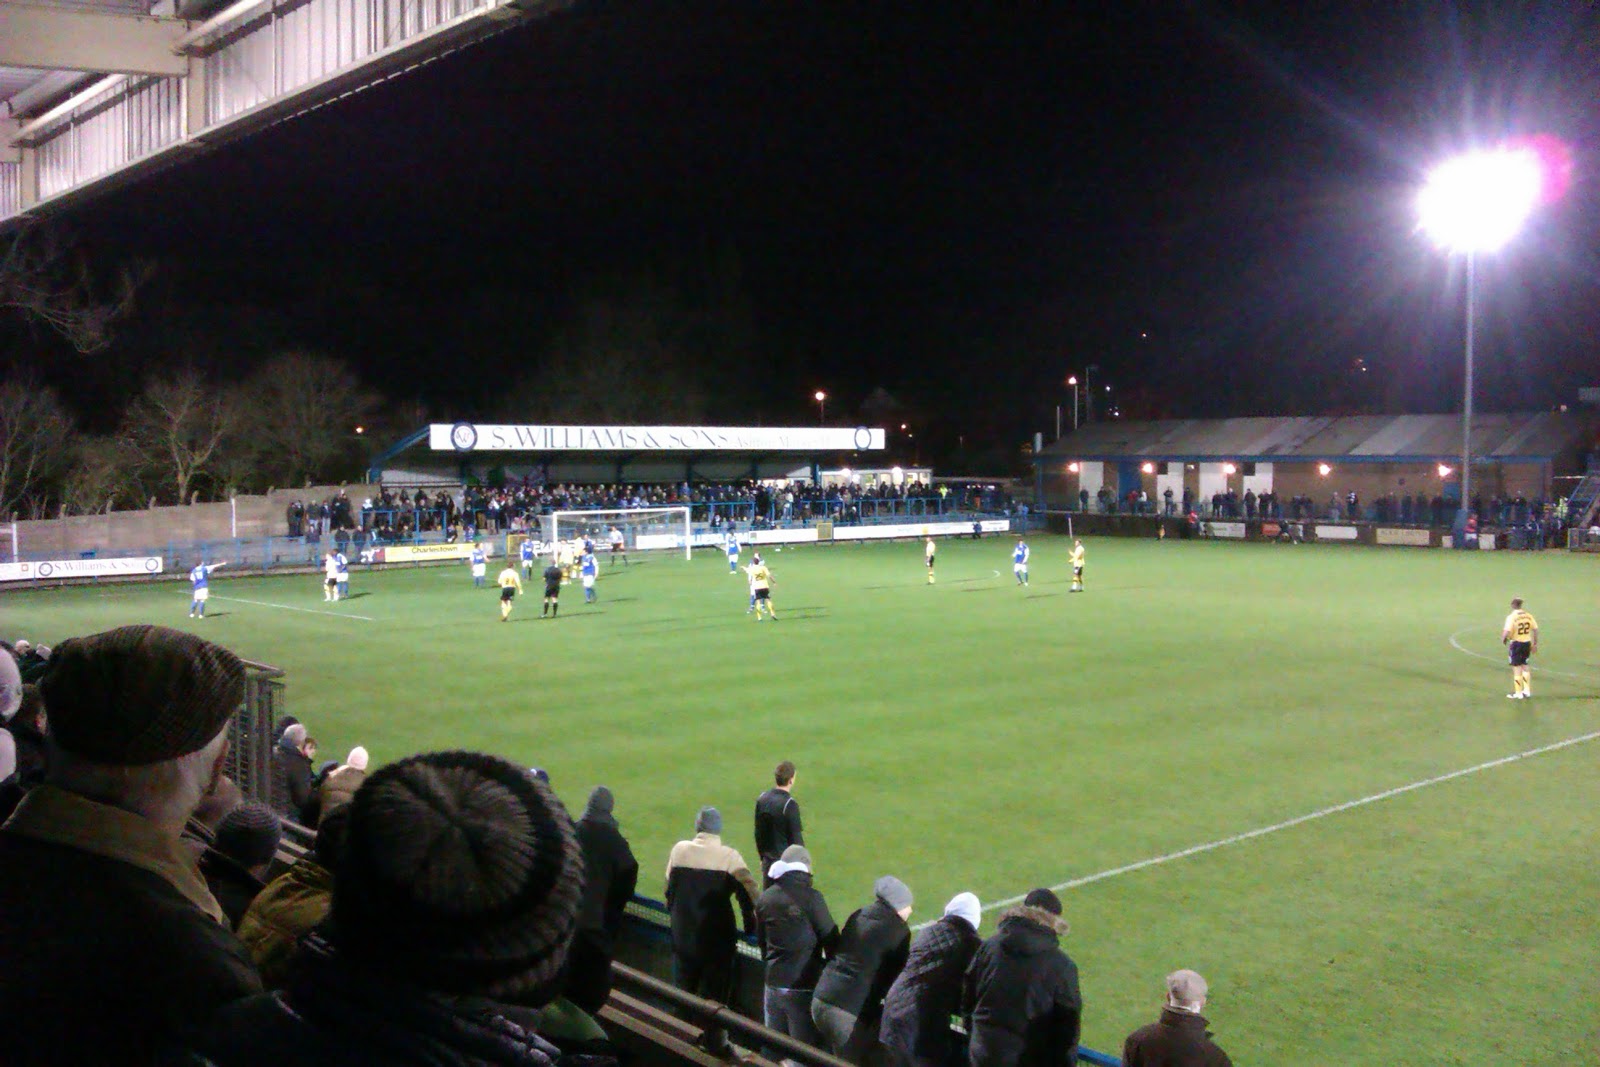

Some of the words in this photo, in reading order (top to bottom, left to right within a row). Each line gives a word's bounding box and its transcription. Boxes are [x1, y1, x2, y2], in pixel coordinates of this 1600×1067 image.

[643, 430, 662, 448] &
[667, 428, 728, 449] SONS
[412, 544, 459, 554] Charlestown
[1517, 622, 1531, 635] 22
